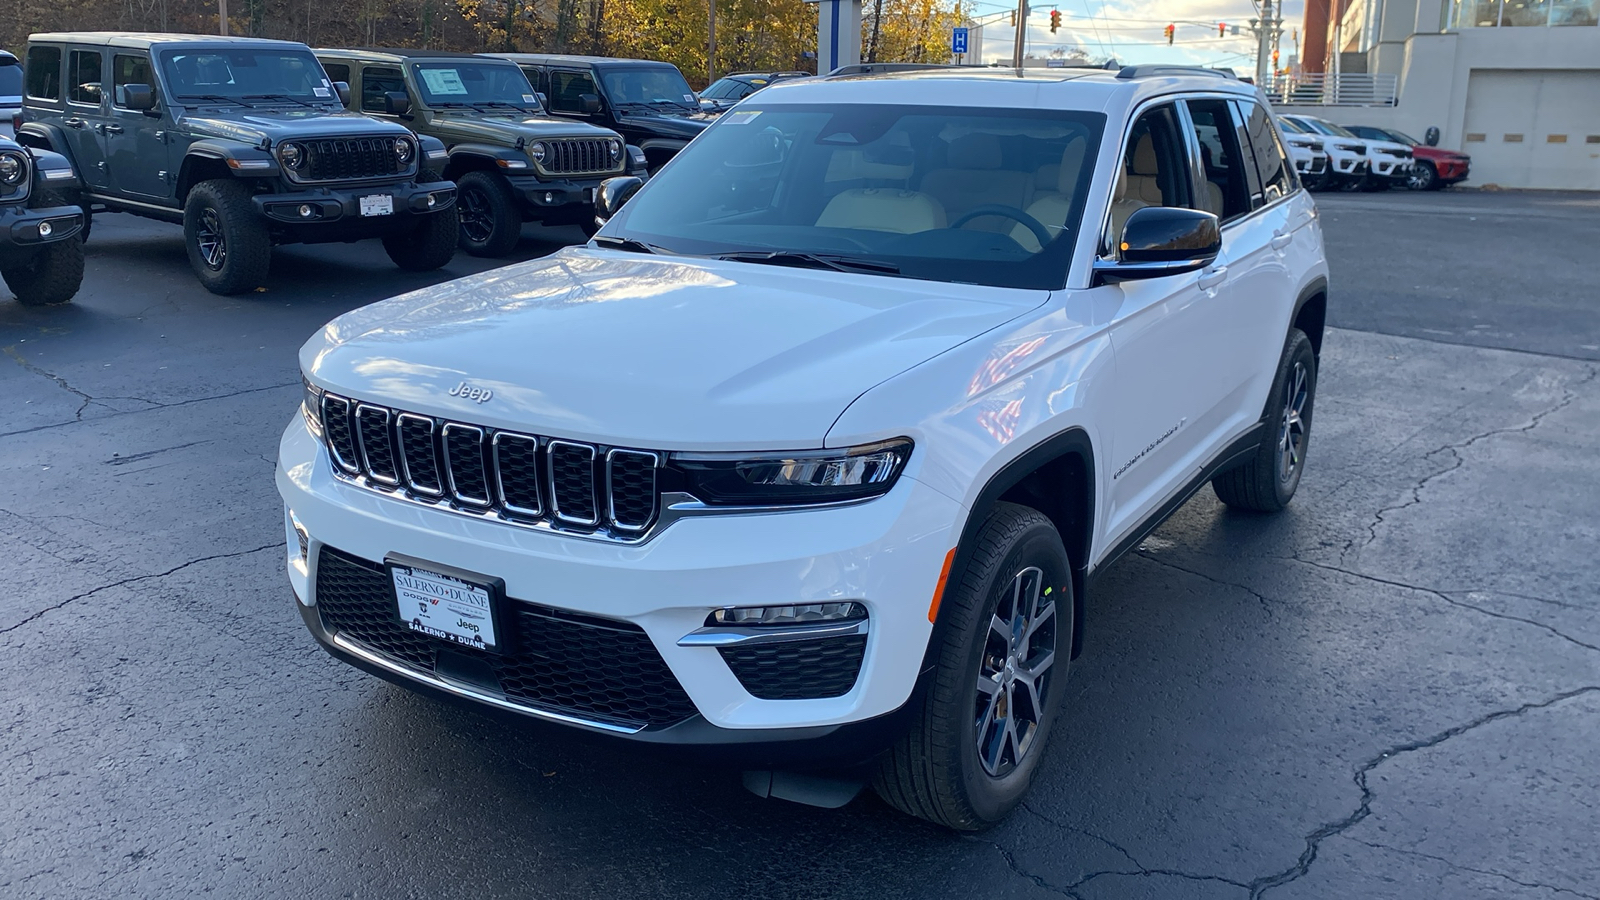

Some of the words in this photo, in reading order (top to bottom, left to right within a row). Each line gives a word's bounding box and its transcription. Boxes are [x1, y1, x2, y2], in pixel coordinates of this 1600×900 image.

[956, 33, 965, 46] H
[448, 381, 493, 404] Jeep
[396, 576, 444, 596] SALERNO
[450, 588, 488, 608] DUANE
[408, 622, 446, 639] SALERNO
[458, 636, 486, 650] DUANE
[456, 618, 480, 633] Jeep
